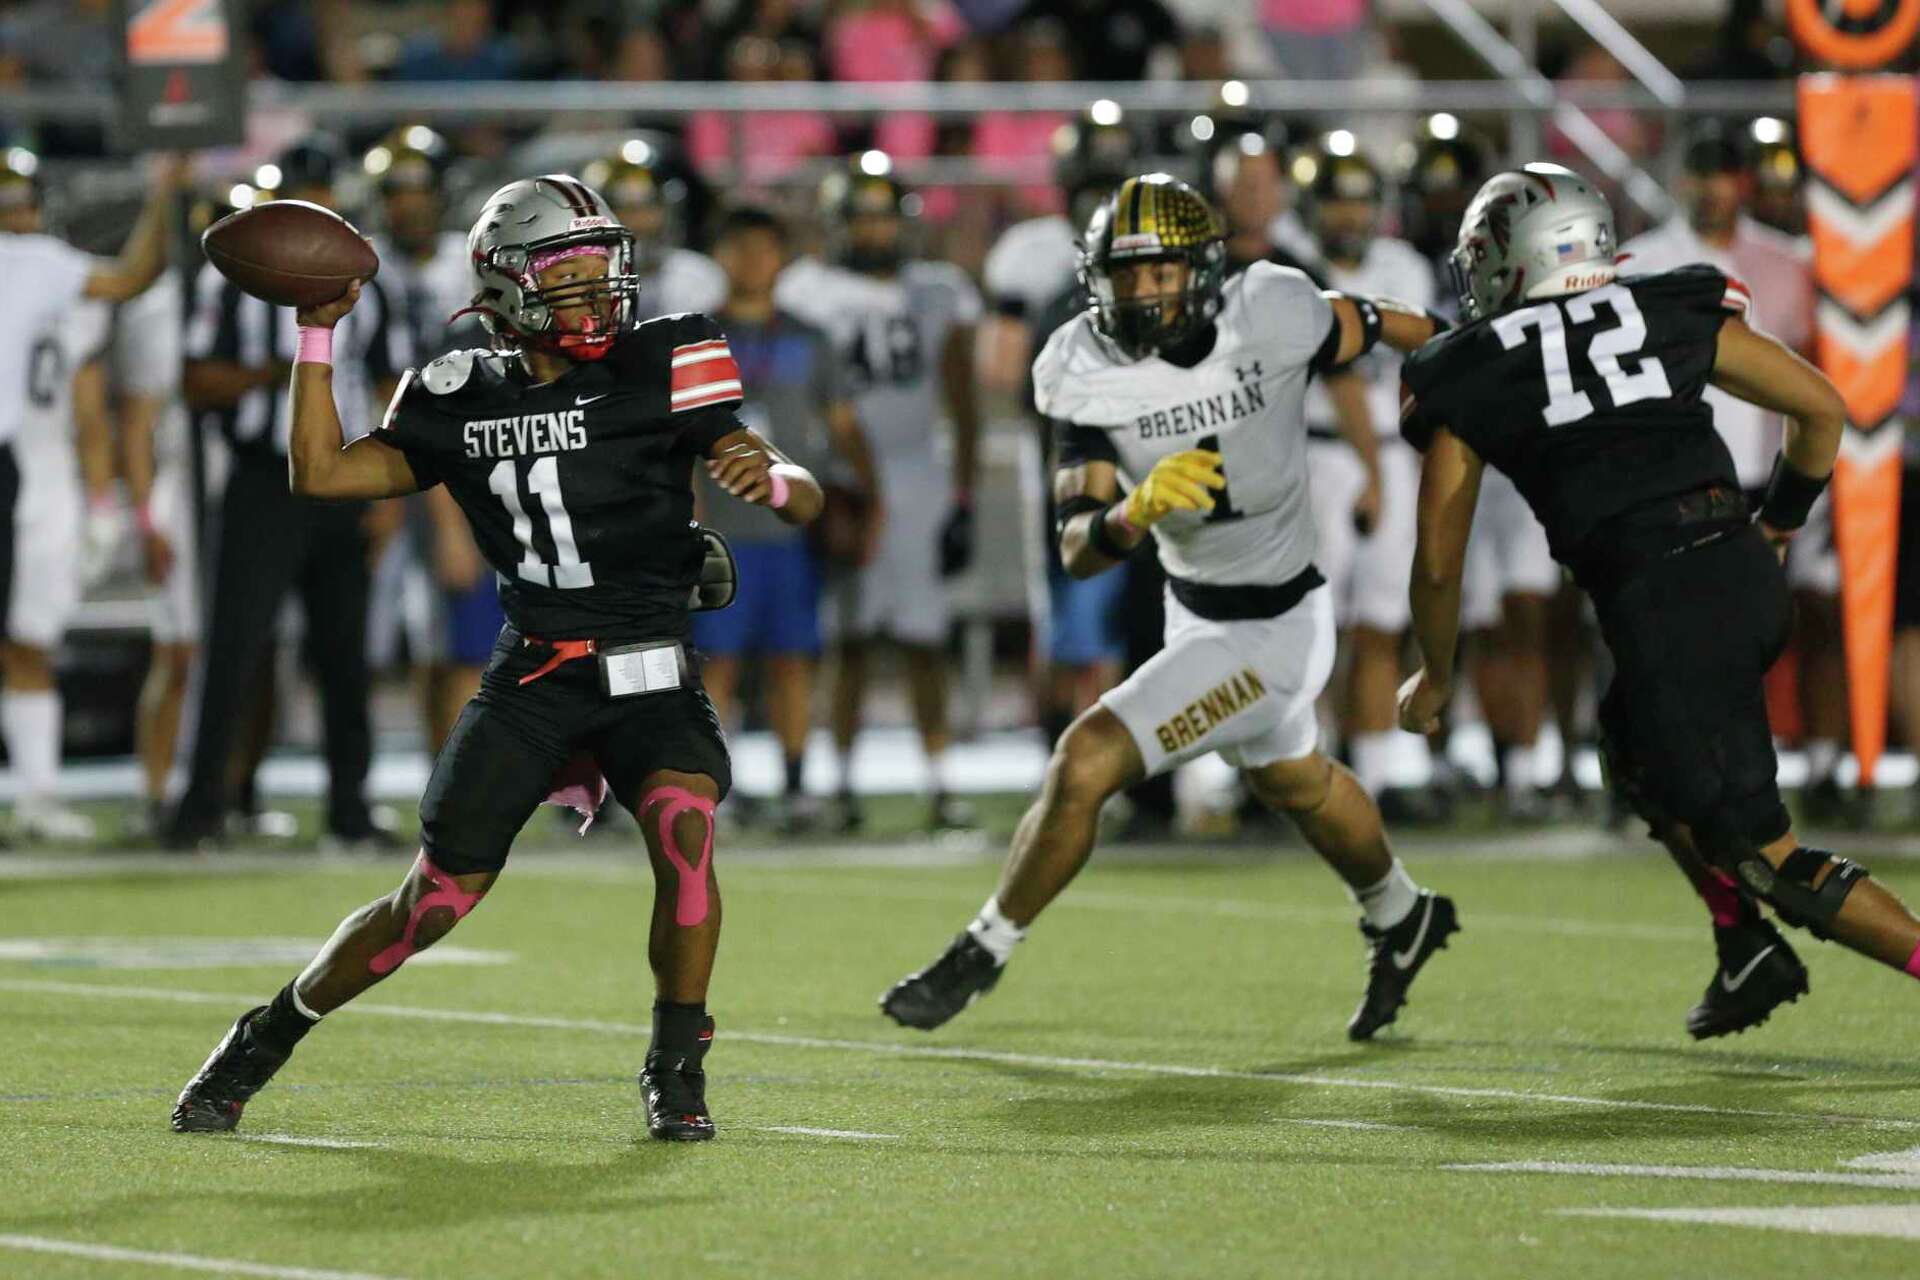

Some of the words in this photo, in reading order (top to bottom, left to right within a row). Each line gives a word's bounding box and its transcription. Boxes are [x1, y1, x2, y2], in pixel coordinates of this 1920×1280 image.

[1490, 282, 1673, 427] 72
[463, 409, 588, 458] STEVENS
[1137, 382, 1266, 439] BRENNAN
[488, 455, 596, 589] 11
[1156, 667, 1267, 753] BRENNAN
